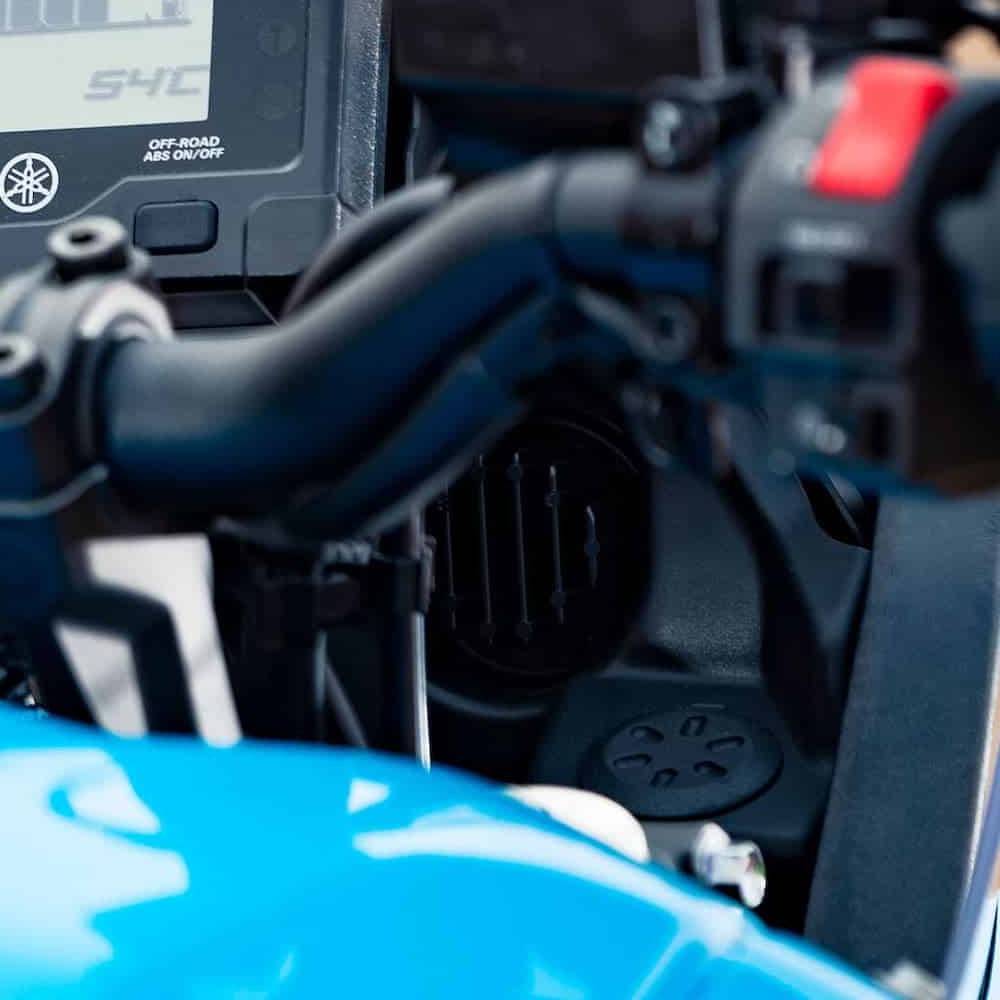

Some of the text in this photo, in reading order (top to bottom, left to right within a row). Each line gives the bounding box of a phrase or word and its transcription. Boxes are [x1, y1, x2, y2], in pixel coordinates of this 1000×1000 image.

[148, 136, 220, 151] OFF-ROAD
[143, 147, 225, 162] ABS ON/OFF
